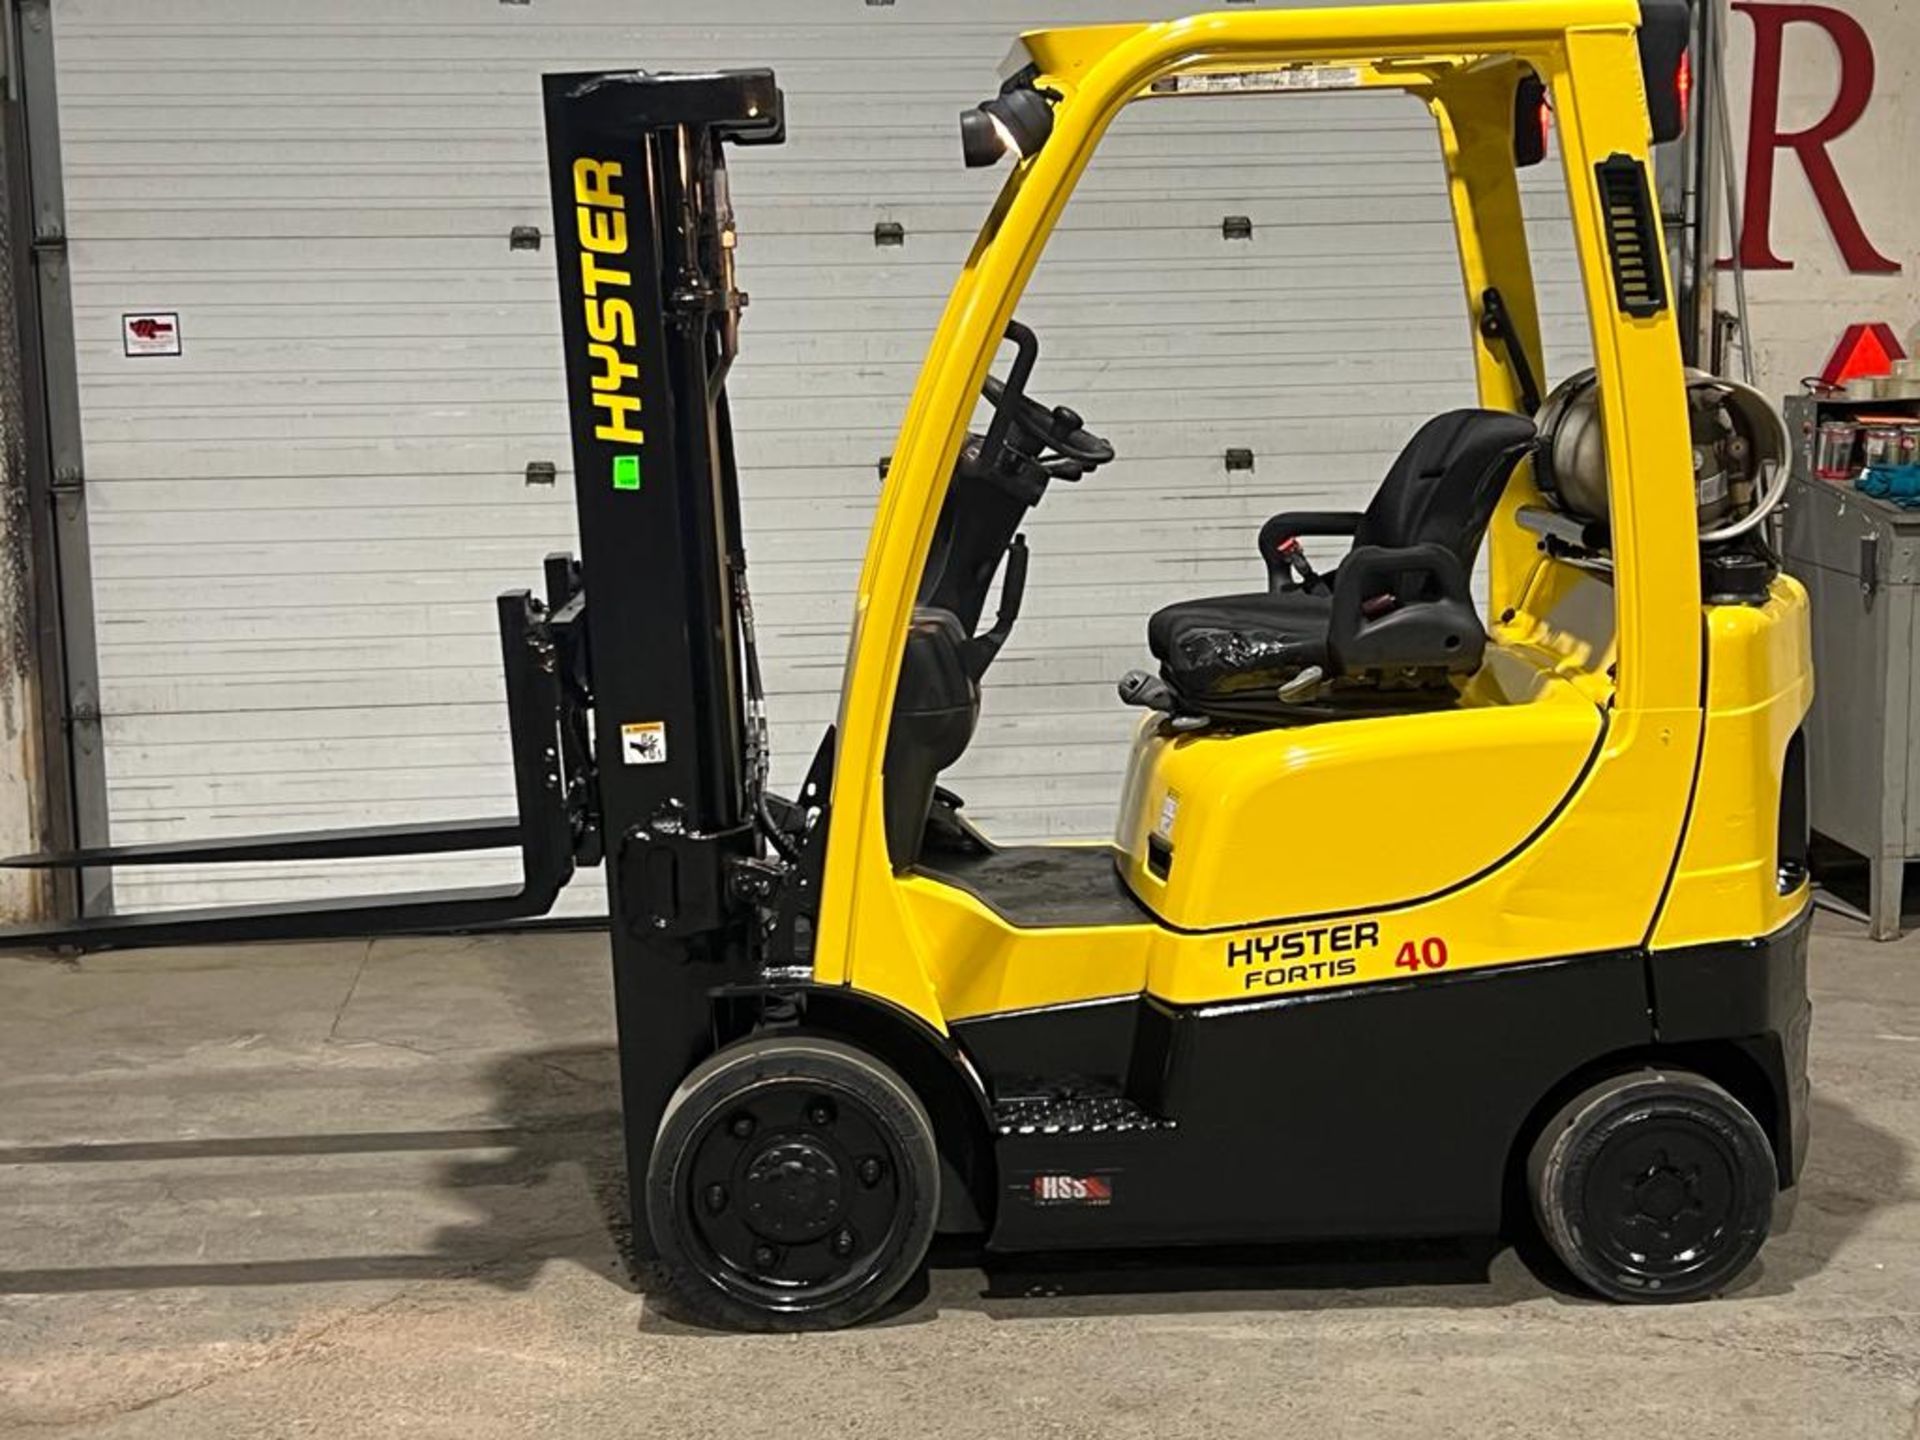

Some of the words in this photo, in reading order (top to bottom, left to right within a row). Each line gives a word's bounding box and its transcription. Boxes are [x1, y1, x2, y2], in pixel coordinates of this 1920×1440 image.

[1714, 2, 1902, 273] R
[573, 157, 644, 444] HYSTER
[1228, 921, 1379, 968] HYSTER
[1394, 936, 1448, 972] 40
[1245, 958, 1357, 990] FORTIS
[1042, 1176, 1087, 1199] HSS
